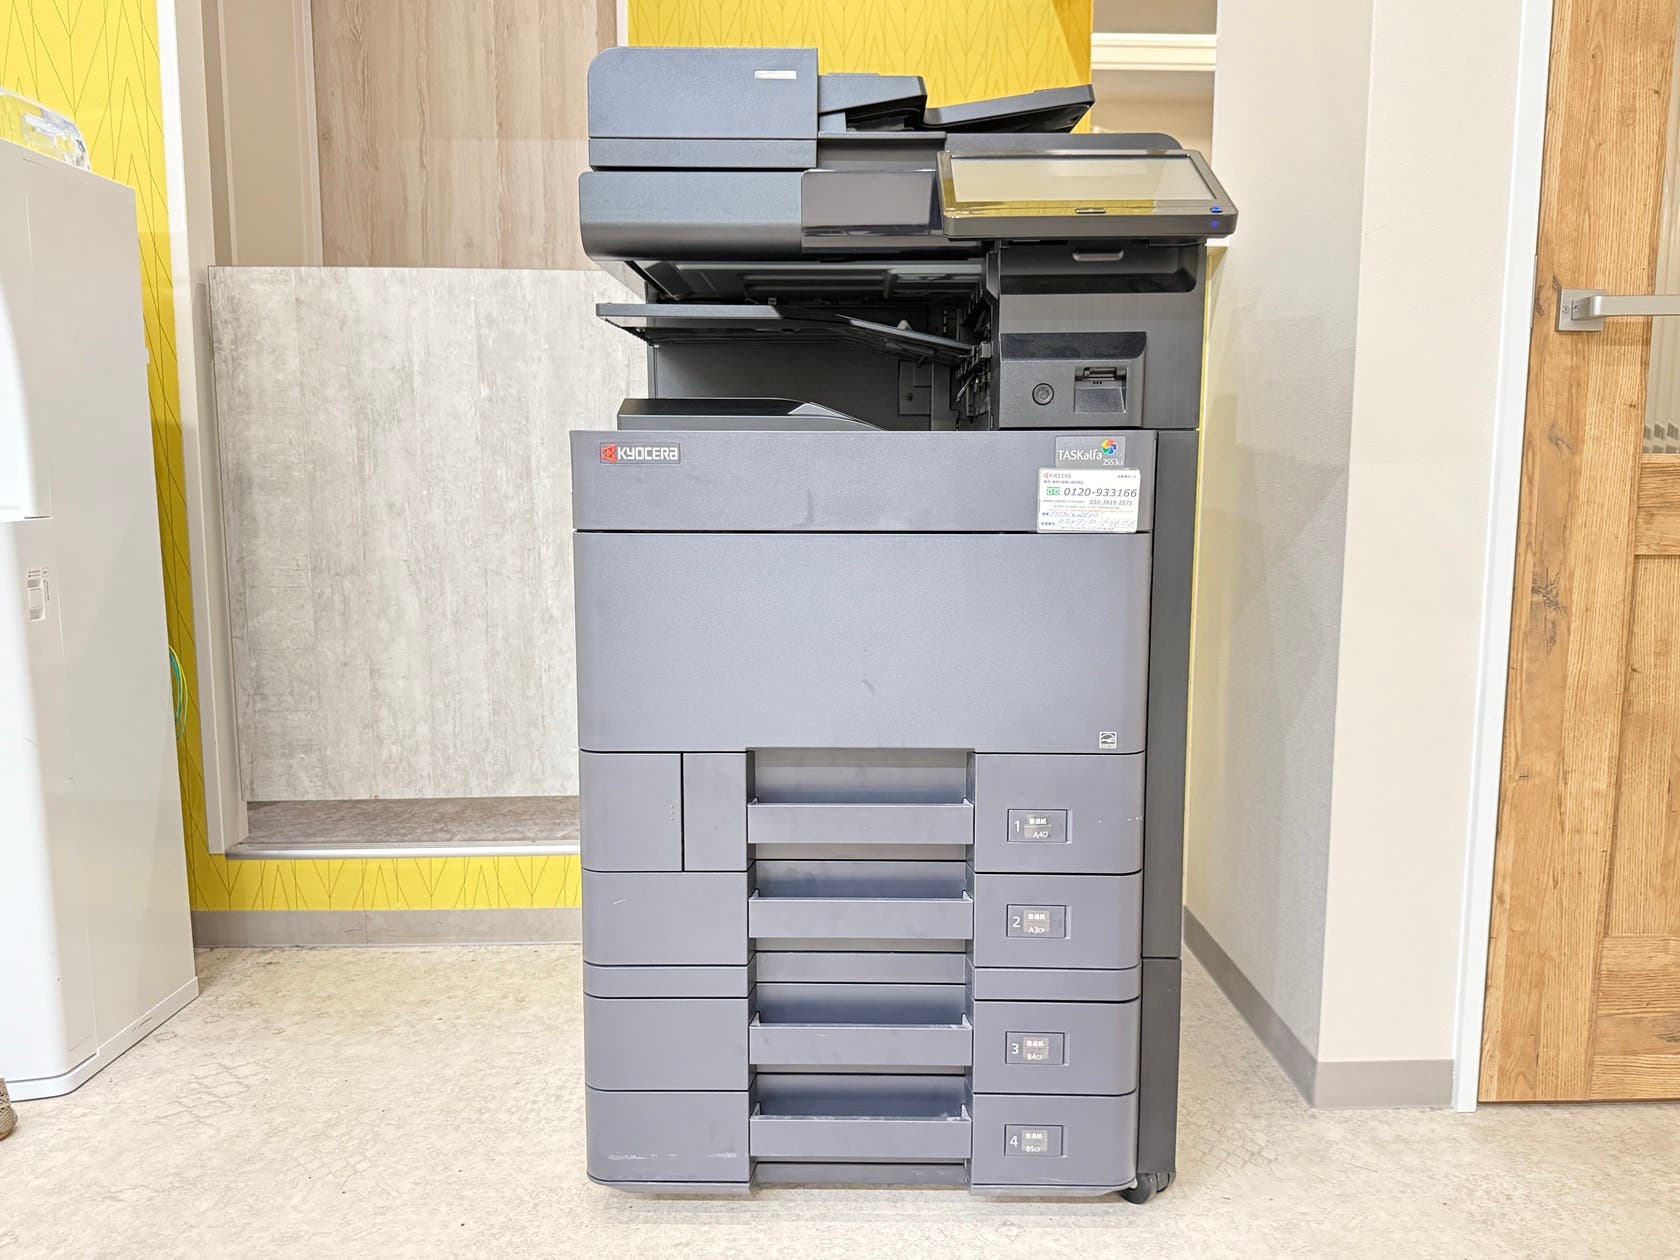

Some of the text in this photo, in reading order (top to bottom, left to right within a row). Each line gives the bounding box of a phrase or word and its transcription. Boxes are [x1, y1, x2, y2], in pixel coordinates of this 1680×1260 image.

[617, 446, 678, 460] KYOCERA
[1057, 449, 1102, 461] TASKalfa
[1063, 487, 1137, 498] 0120-933166
[1014, 820, 1020, 832] 1
[1012, 915, 1020, 928] 2
[1011, 1042, 1020, 1055] 3
[1009, 1135, 1019, 1147] 4
